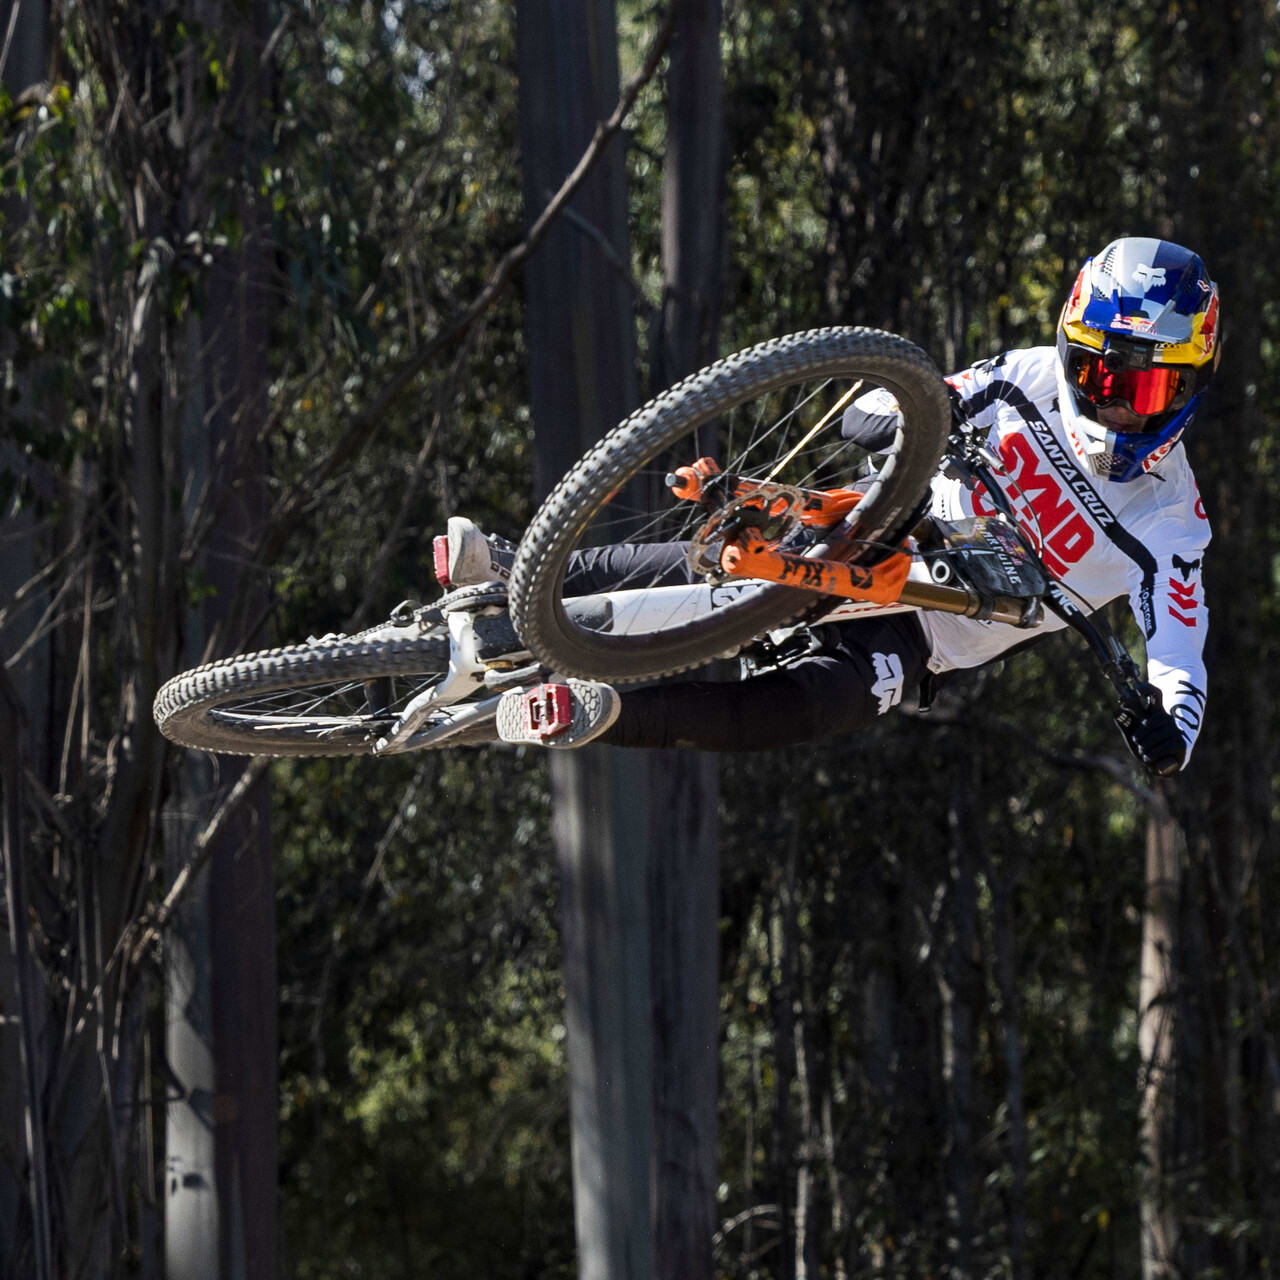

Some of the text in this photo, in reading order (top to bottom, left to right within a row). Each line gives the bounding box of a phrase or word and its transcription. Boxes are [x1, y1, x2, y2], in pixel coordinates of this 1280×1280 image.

[1028, 420, 1078, 480] SANTA
[1071, 480, 1115, 528] CRUZ
[778, 556, 825, 586] FOX
